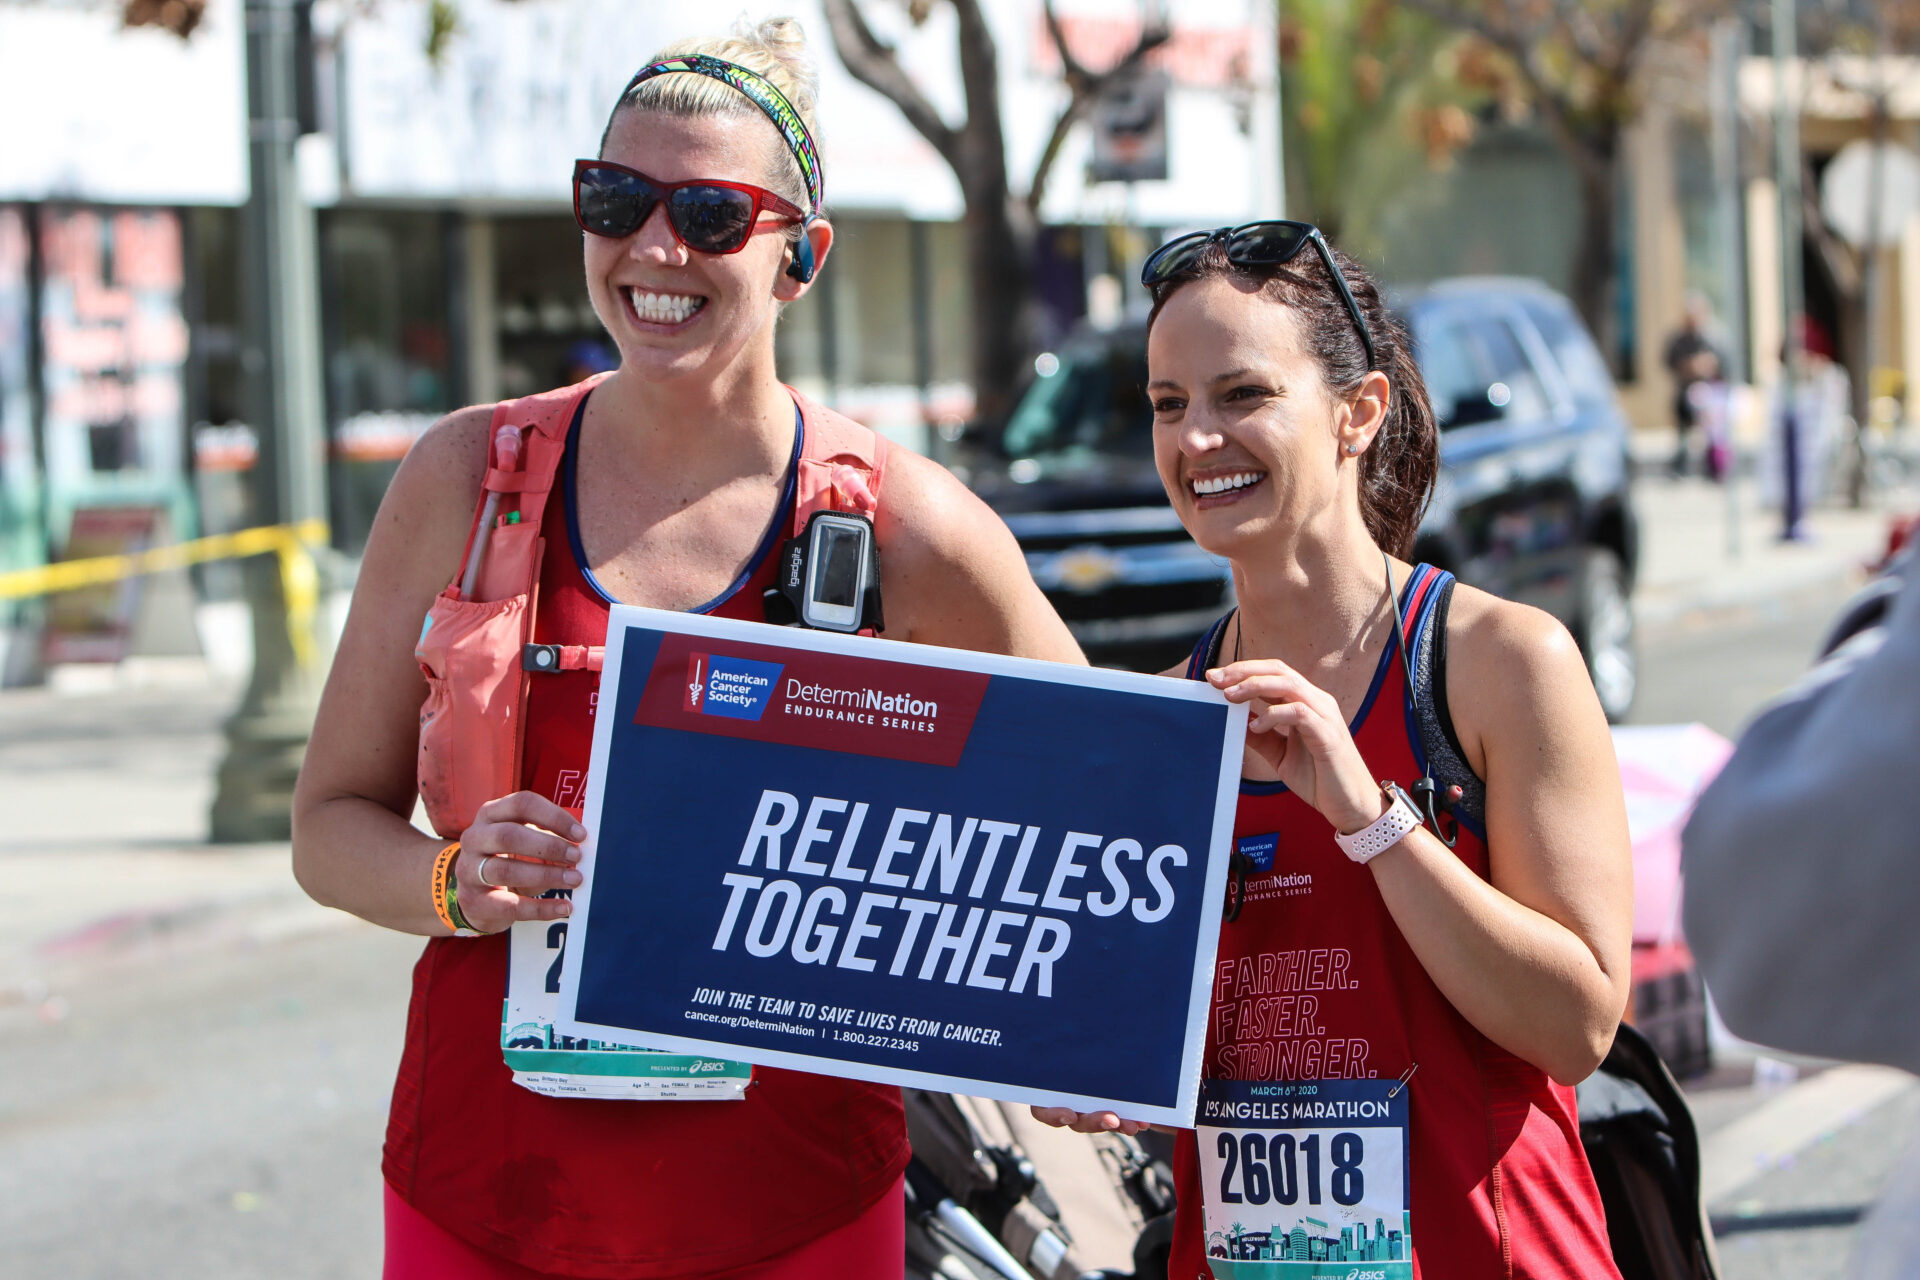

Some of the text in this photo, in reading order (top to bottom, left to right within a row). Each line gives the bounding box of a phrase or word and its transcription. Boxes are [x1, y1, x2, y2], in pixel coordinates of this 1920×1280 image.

[728, 66, 807, 143] MARATHON
[710, 680, 751, 695] Cancer
[711, 669, 768, 686] American
[786, 678, 938, 718] DetermiNation
[785, 703, 936, 733] ENDURANCE SERIES
[737, 789, 1188, 923] RELENTLESS
[1240, 842, 1273, 853] American
[434, 848, 452, 921] CHARITY
[1229, 872, 1312, 896] DtermiNation
[1285, 887, 1312, 897] SERIES
[711, 872, 1071, 998] TOGETHER
[1215, 948, 1359, 1002] FARTHER.
[684, 1009, 919, 1052] cancer.org/DetermiNation 1.800.227.2345
[691, 987, 1003, 1047] JOIN THE TEAM TO SAVE LIVES FROM CANCER.
[1215, 995, 1326, 1044] FASTER.
[1218, 1038, 1378, 1081] STRONGER.
[1204, 1100, 1389, 1120] LOS ANGELES MARATHON
[1250, 1086, 1284, 1096] MARCH
[1298, 1085, 1318, 1095] 2020
[1217, 1132, 1365, 1206] 26018
